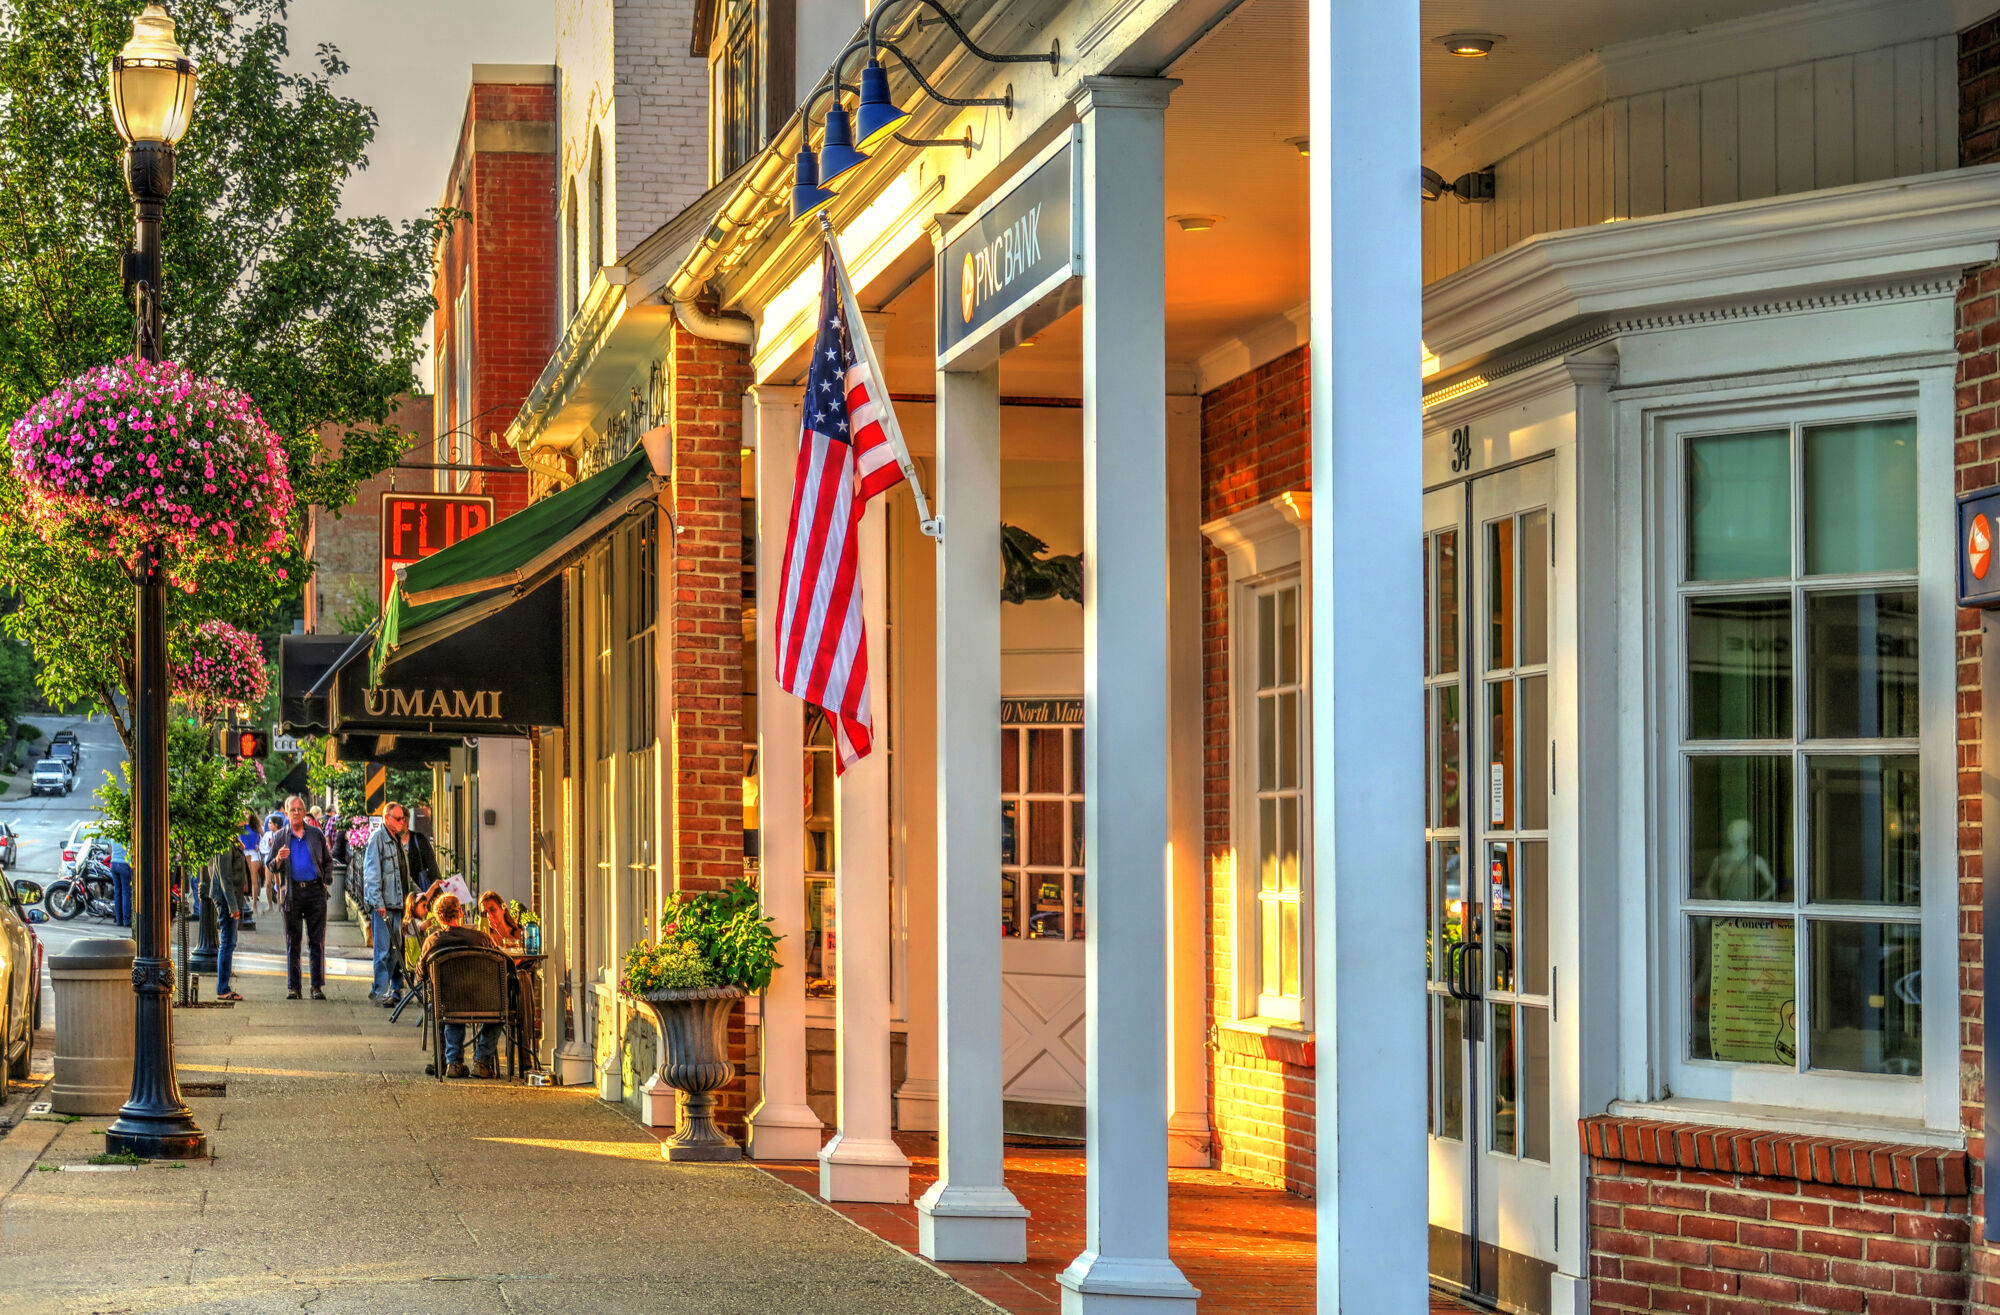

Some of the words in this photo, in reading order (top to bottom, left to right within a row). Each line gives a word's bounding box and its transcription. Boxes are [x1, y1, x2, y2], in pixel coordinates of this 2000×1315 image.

[1452, 425, 1471, 472] 34
[361, 687, 503, 719] UMAMI
[1013, 701, 1049, 721] North
[1734, 918, 1774, 929] Concert
